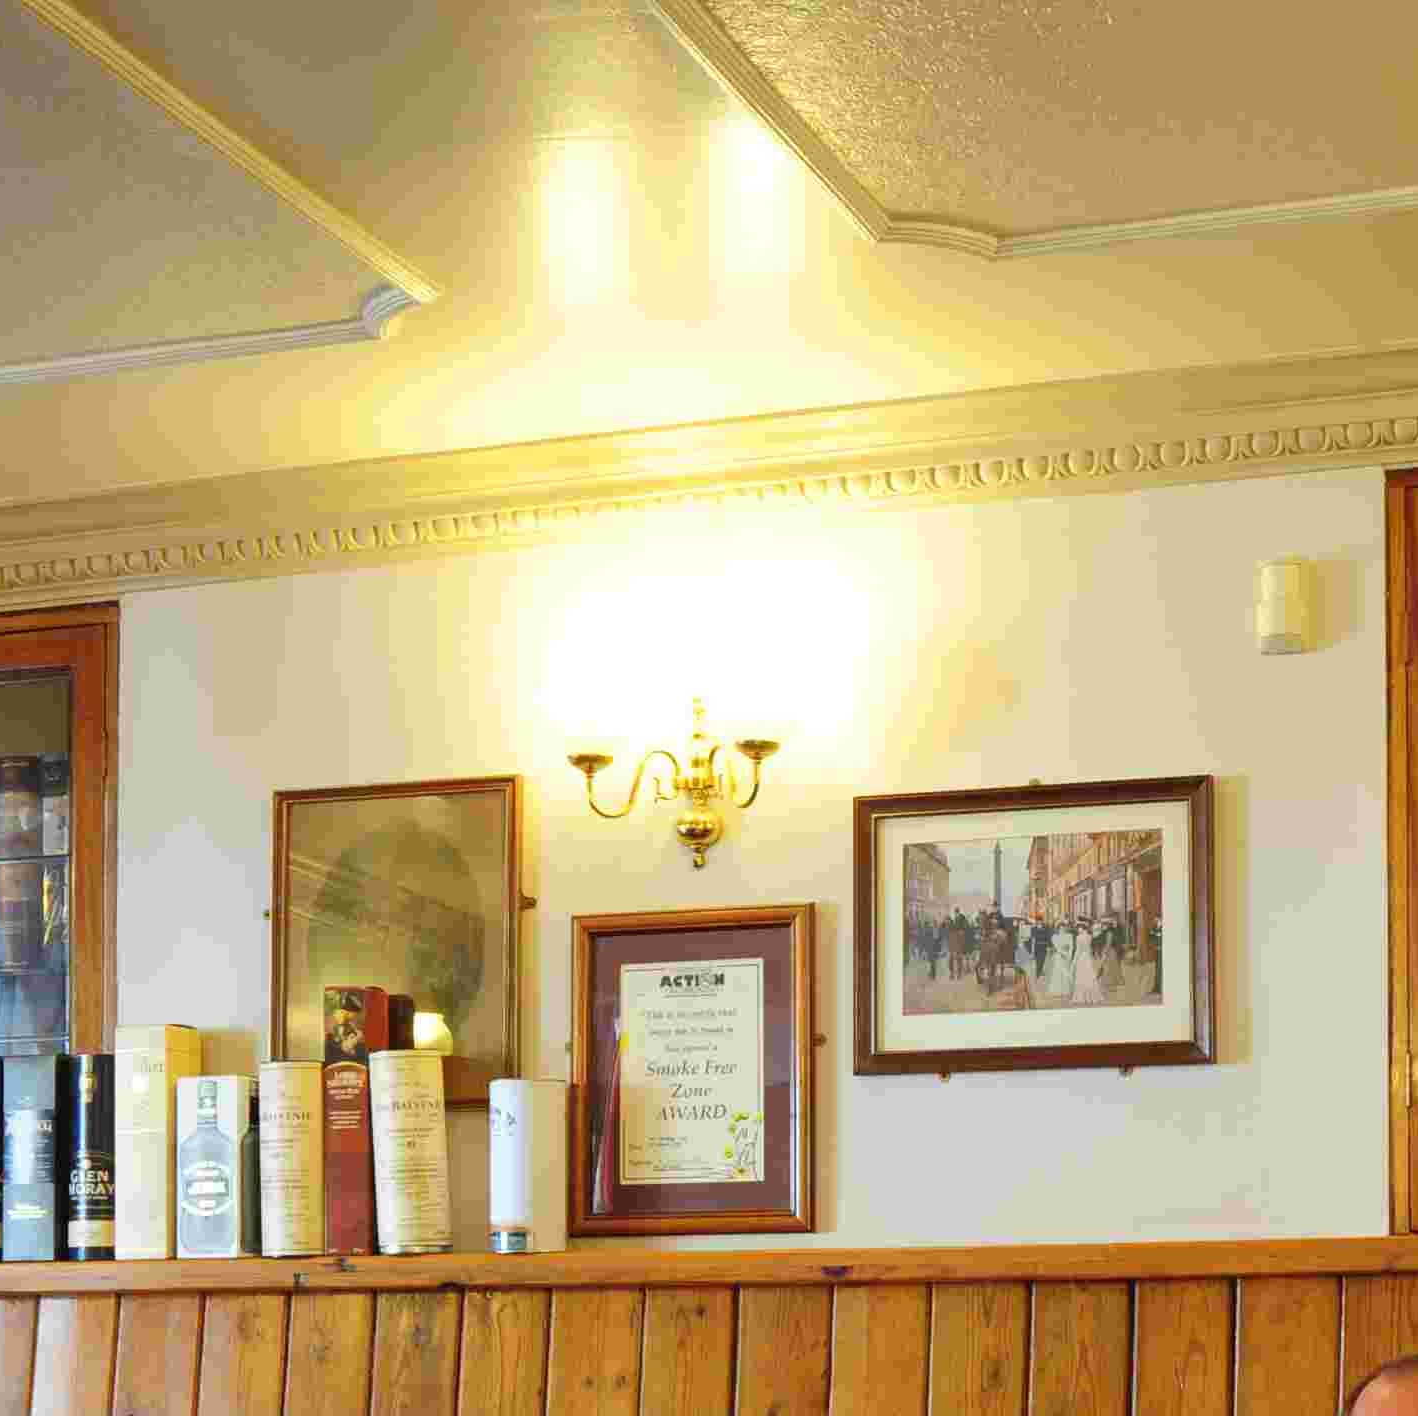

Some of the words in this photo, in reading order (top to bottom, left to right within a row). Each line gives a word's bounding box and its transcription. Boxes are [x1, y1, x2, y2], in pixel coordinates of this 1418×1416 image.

[660, 974, 725, 987] ACTIN
[645, 1060, 701, 1077] Smoke
[704, 1059, 738, 1075] Free
[669, 1083, 713, 1098] Zone
[654, 1104, 727, 1121] AWARD
[70, 1169, 110, 1182] GLEN
